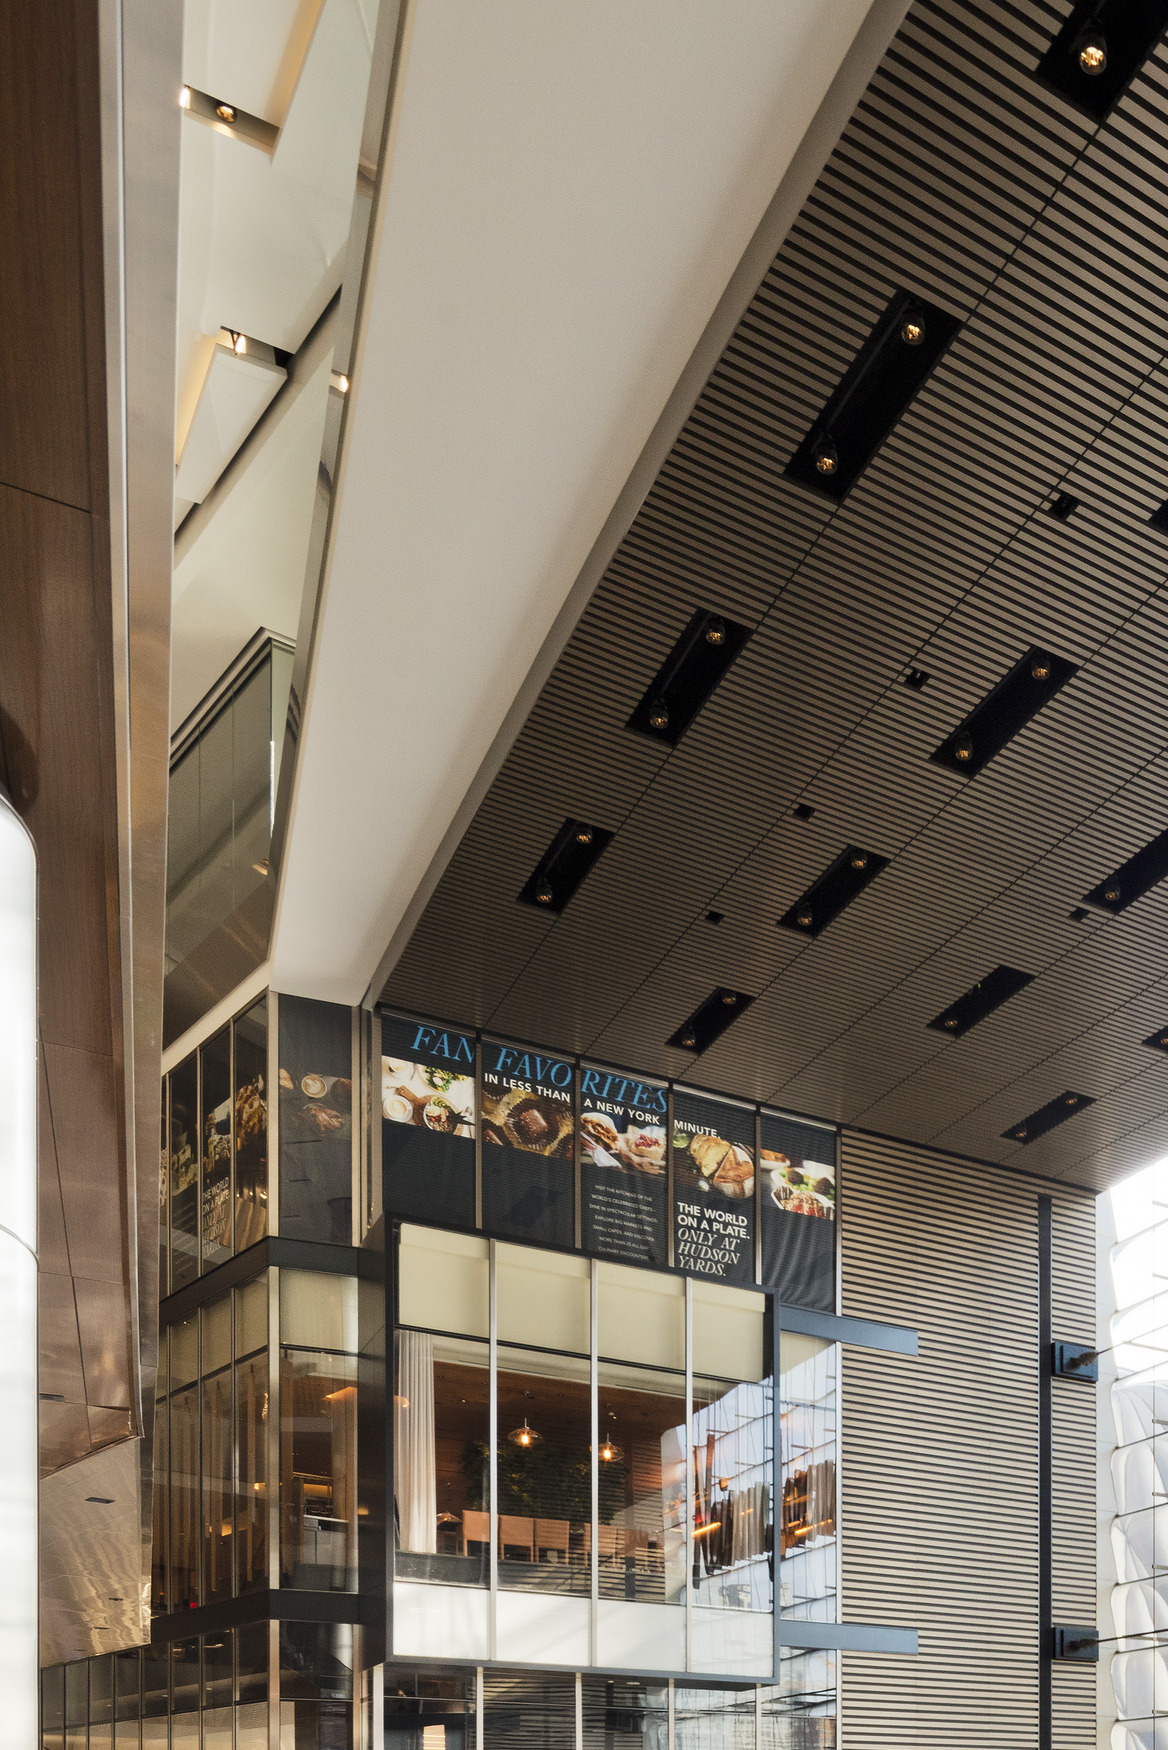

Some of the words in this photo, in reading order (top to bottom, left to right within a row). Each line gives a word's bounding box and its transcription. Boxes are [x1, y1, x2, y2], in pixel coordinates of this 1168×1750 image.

[410, 1026, 475, 1064] FAN
[484, 1073, 498, 1085] IN
[503, 1077, 532, 1093] LESS
[536, 1086, 571, 1103] THAN
[584, 1098, 593, 1108] A
[597, 1102, 624, 1116] NEW
[628, 1108, 660, 1126] YORK
[677, 1202, 701, 1217] THE
[704, 1208, 748, 1226] WORLD
[677, 1215, 697, 1228] ON
[701, 1220, 710, 1231] A
[713, 1223, 750, 1239] PLATE.
[677, 1228, 717, 1246] ONLY
[721, 1238, 740, 1250] AT
[678, 1242, 741, 1265] HUDSON
[678, 1255, 726, 1277] YARDS.
